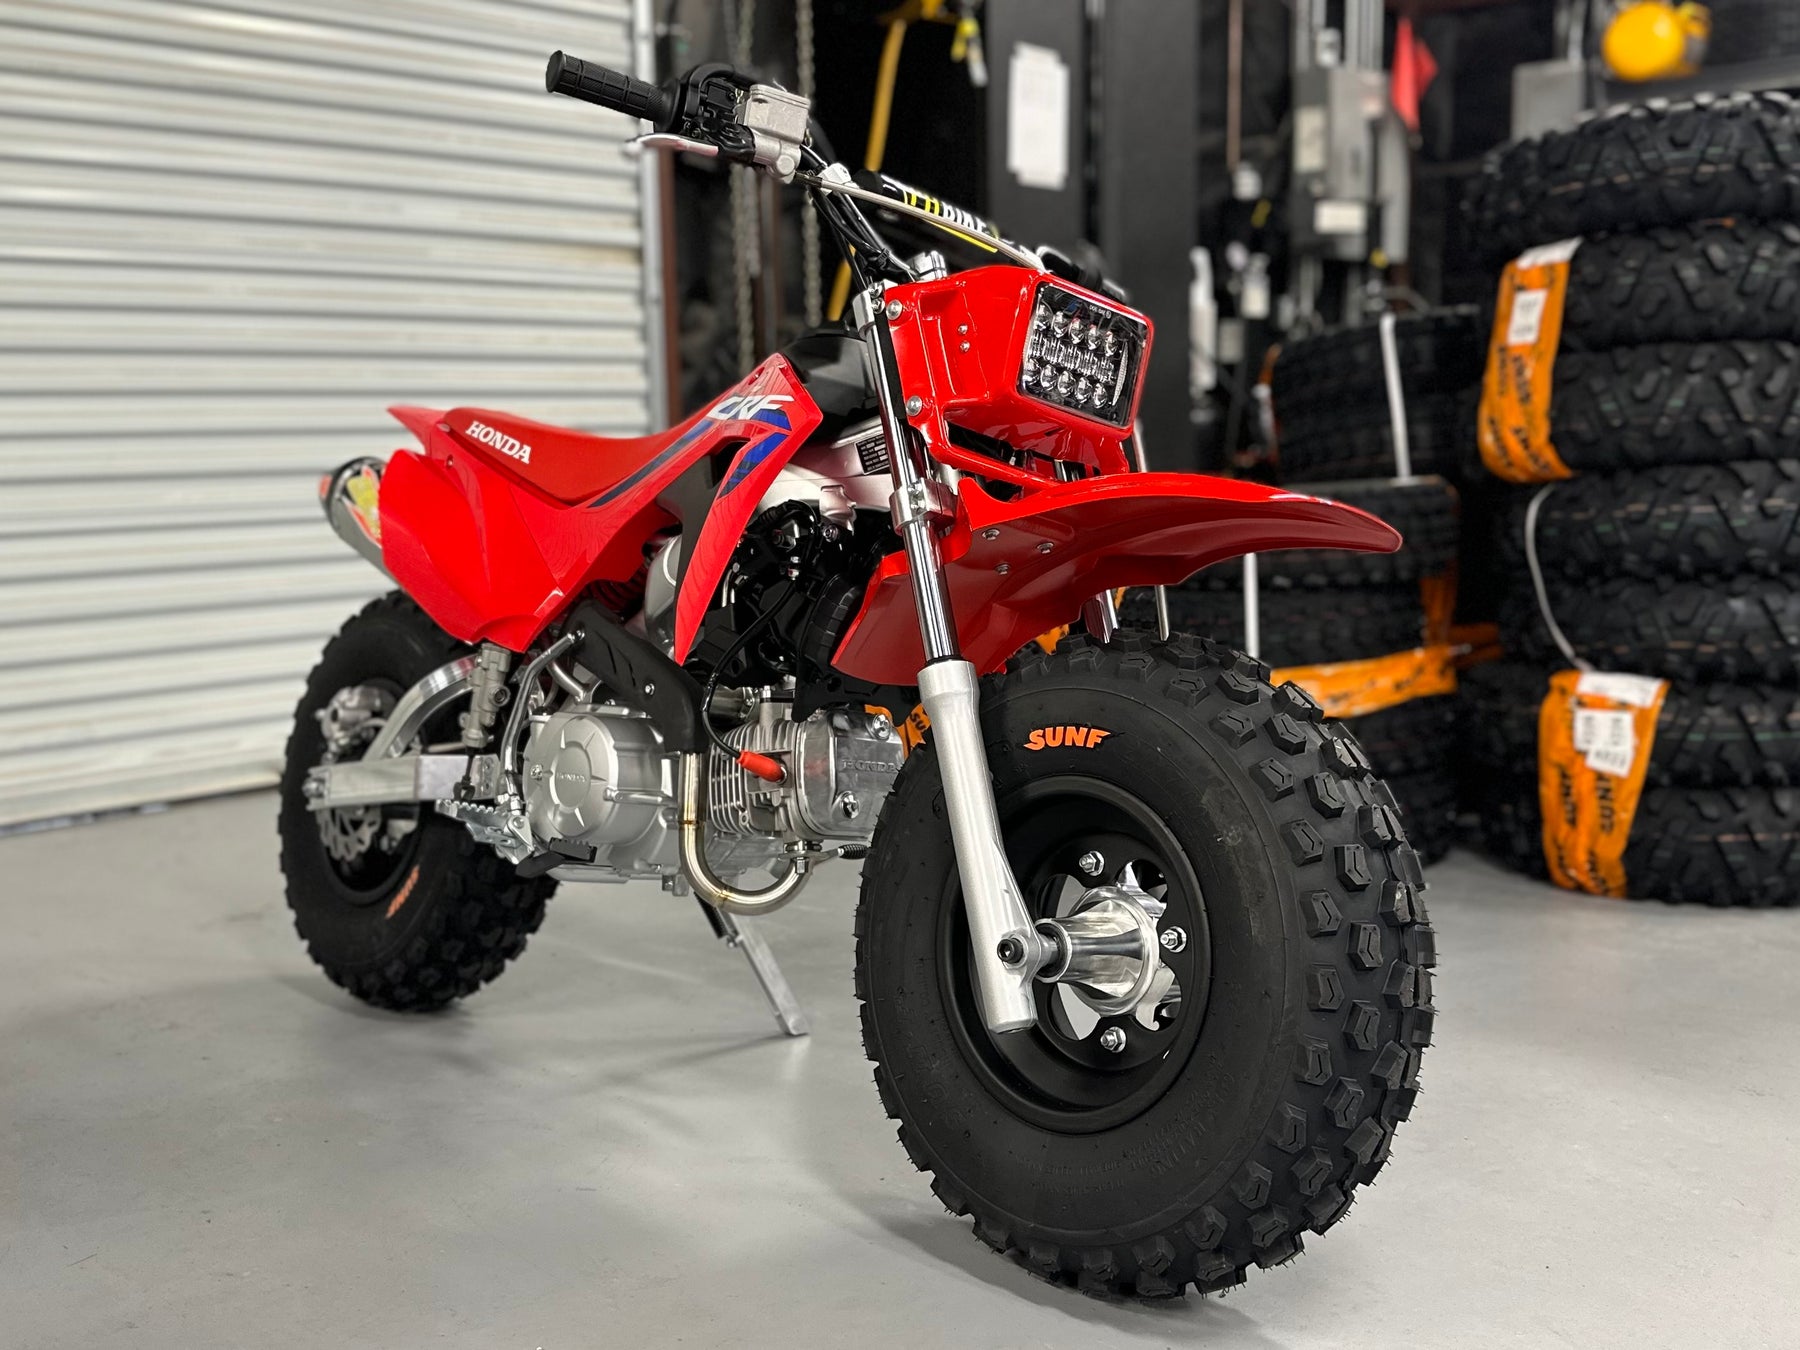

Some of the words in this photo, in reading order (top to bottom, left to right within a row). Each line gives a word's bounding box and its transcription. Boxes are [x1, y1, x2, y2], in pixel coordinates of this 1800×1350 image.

[706, 395, 795, 420] CRF
[465, 420, 532, 465] HONDA
[909, 712, 926, 731] SU
[1023, 726, 1111, 751] SUNF
[840, 760, 898, 773] HONDA
